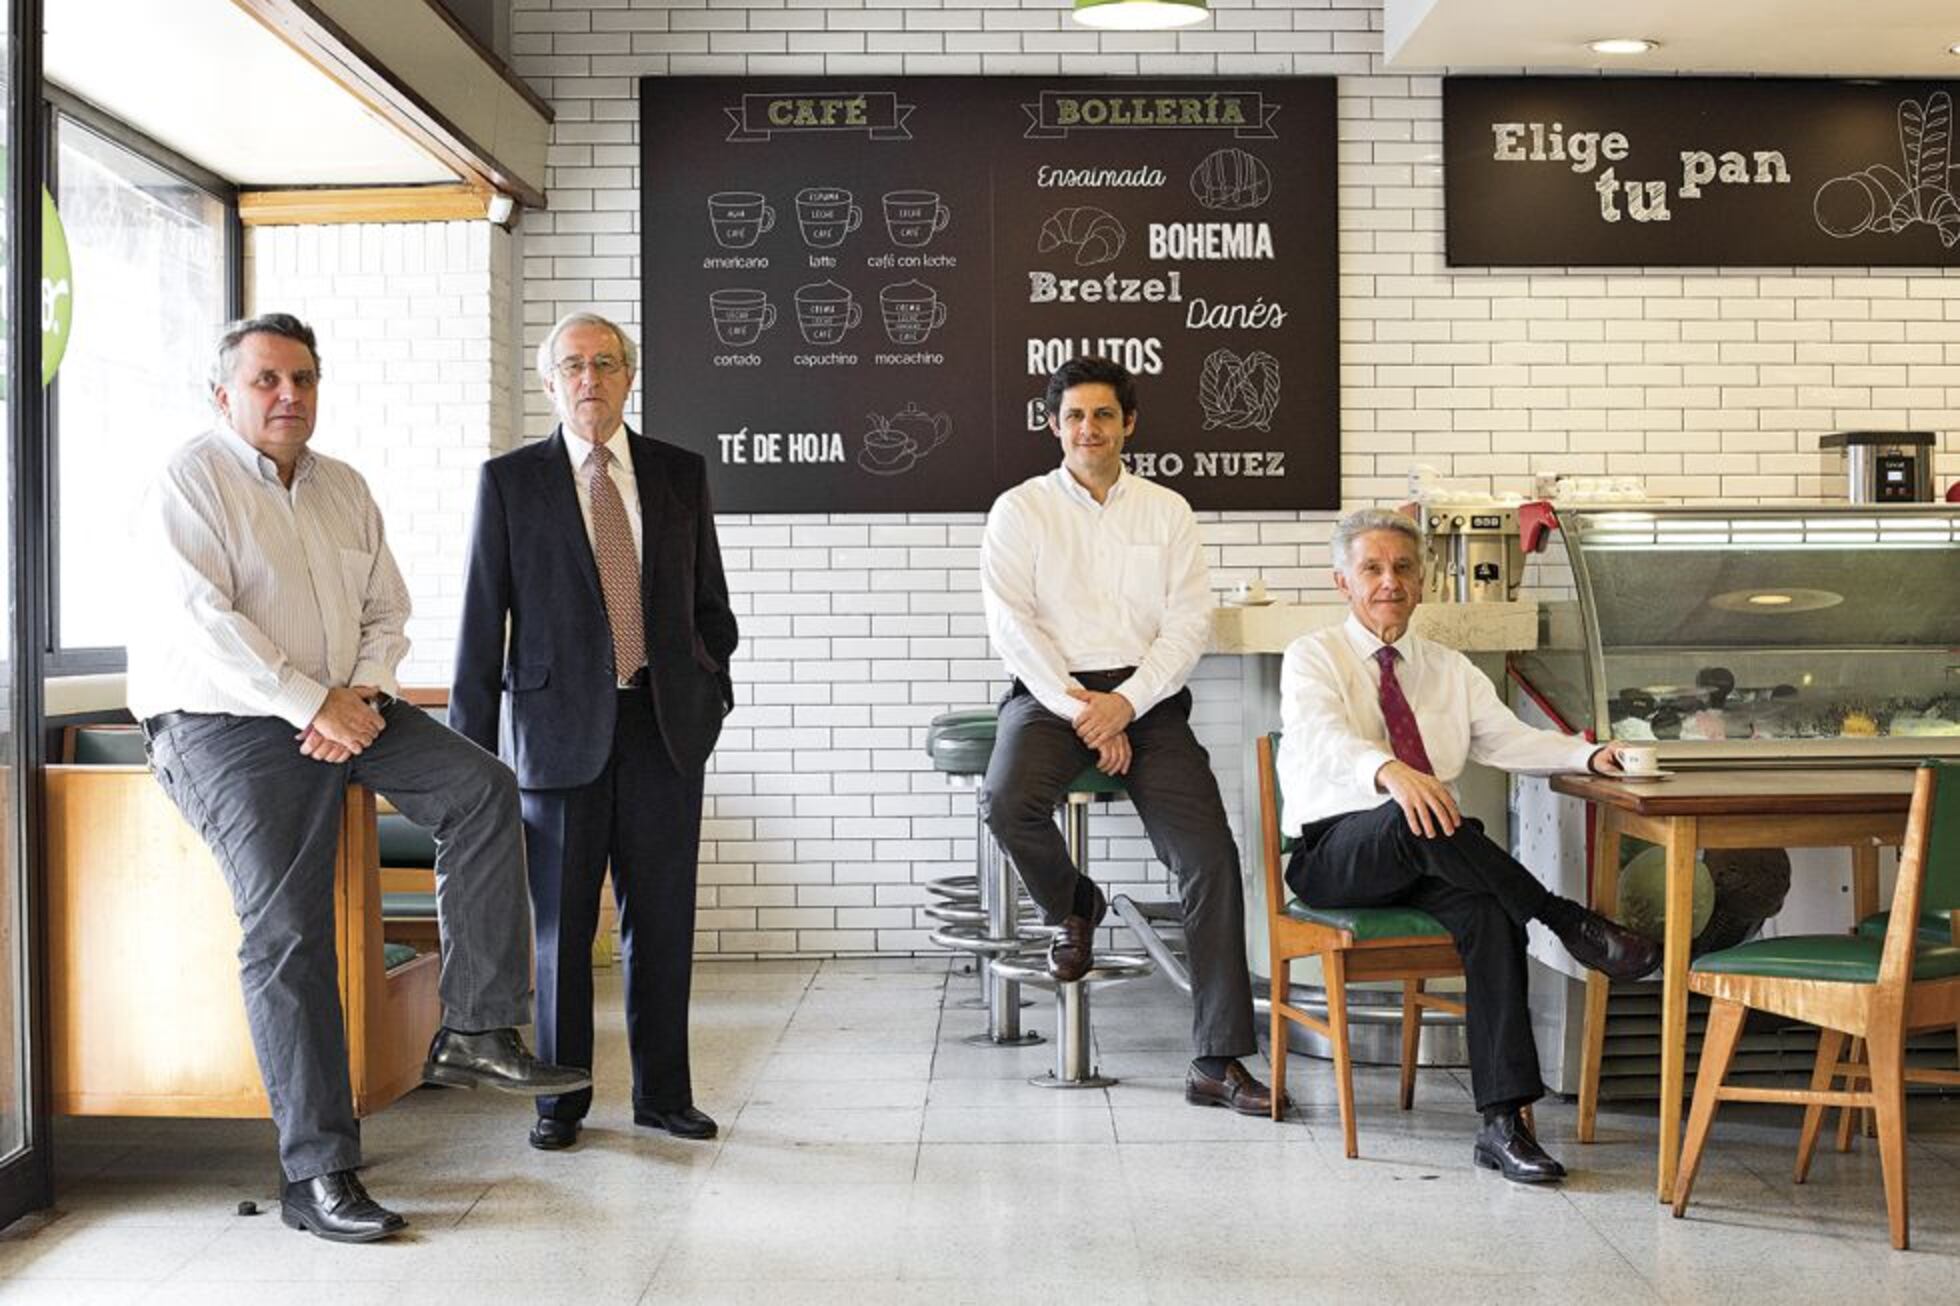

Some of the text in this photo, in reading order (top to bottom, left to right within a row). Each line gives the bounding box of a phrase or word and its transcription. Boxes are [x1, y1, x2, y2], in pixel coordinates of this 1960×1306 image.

[767, 93, 868, 126] CAFÉ
[1056, 93, 1246, 125] BOLLERÍA
[1037, 165, 1167, 187] Ensaimada
[1492, 122, 1791, 222] Elige tu pan
[1149, 223, 1275, 260] BOHEMIA
[703, 256, 769, 269] americano
[808, 254, 838, 269] latte
[867, 253, 957, 269] café con leche
[1028, 270, 1183, 303] Bretzel
[1186, 296, 1288, 329] Danés
[713, 352, 763, 367] cortado
[793, 352, 859, 368] capuchino
[875, 351, 945, 366] mocachino
[718, 426, 846, 464] TÉ DE HOJA
[1194, 452, 1286, 477] NUEZ
